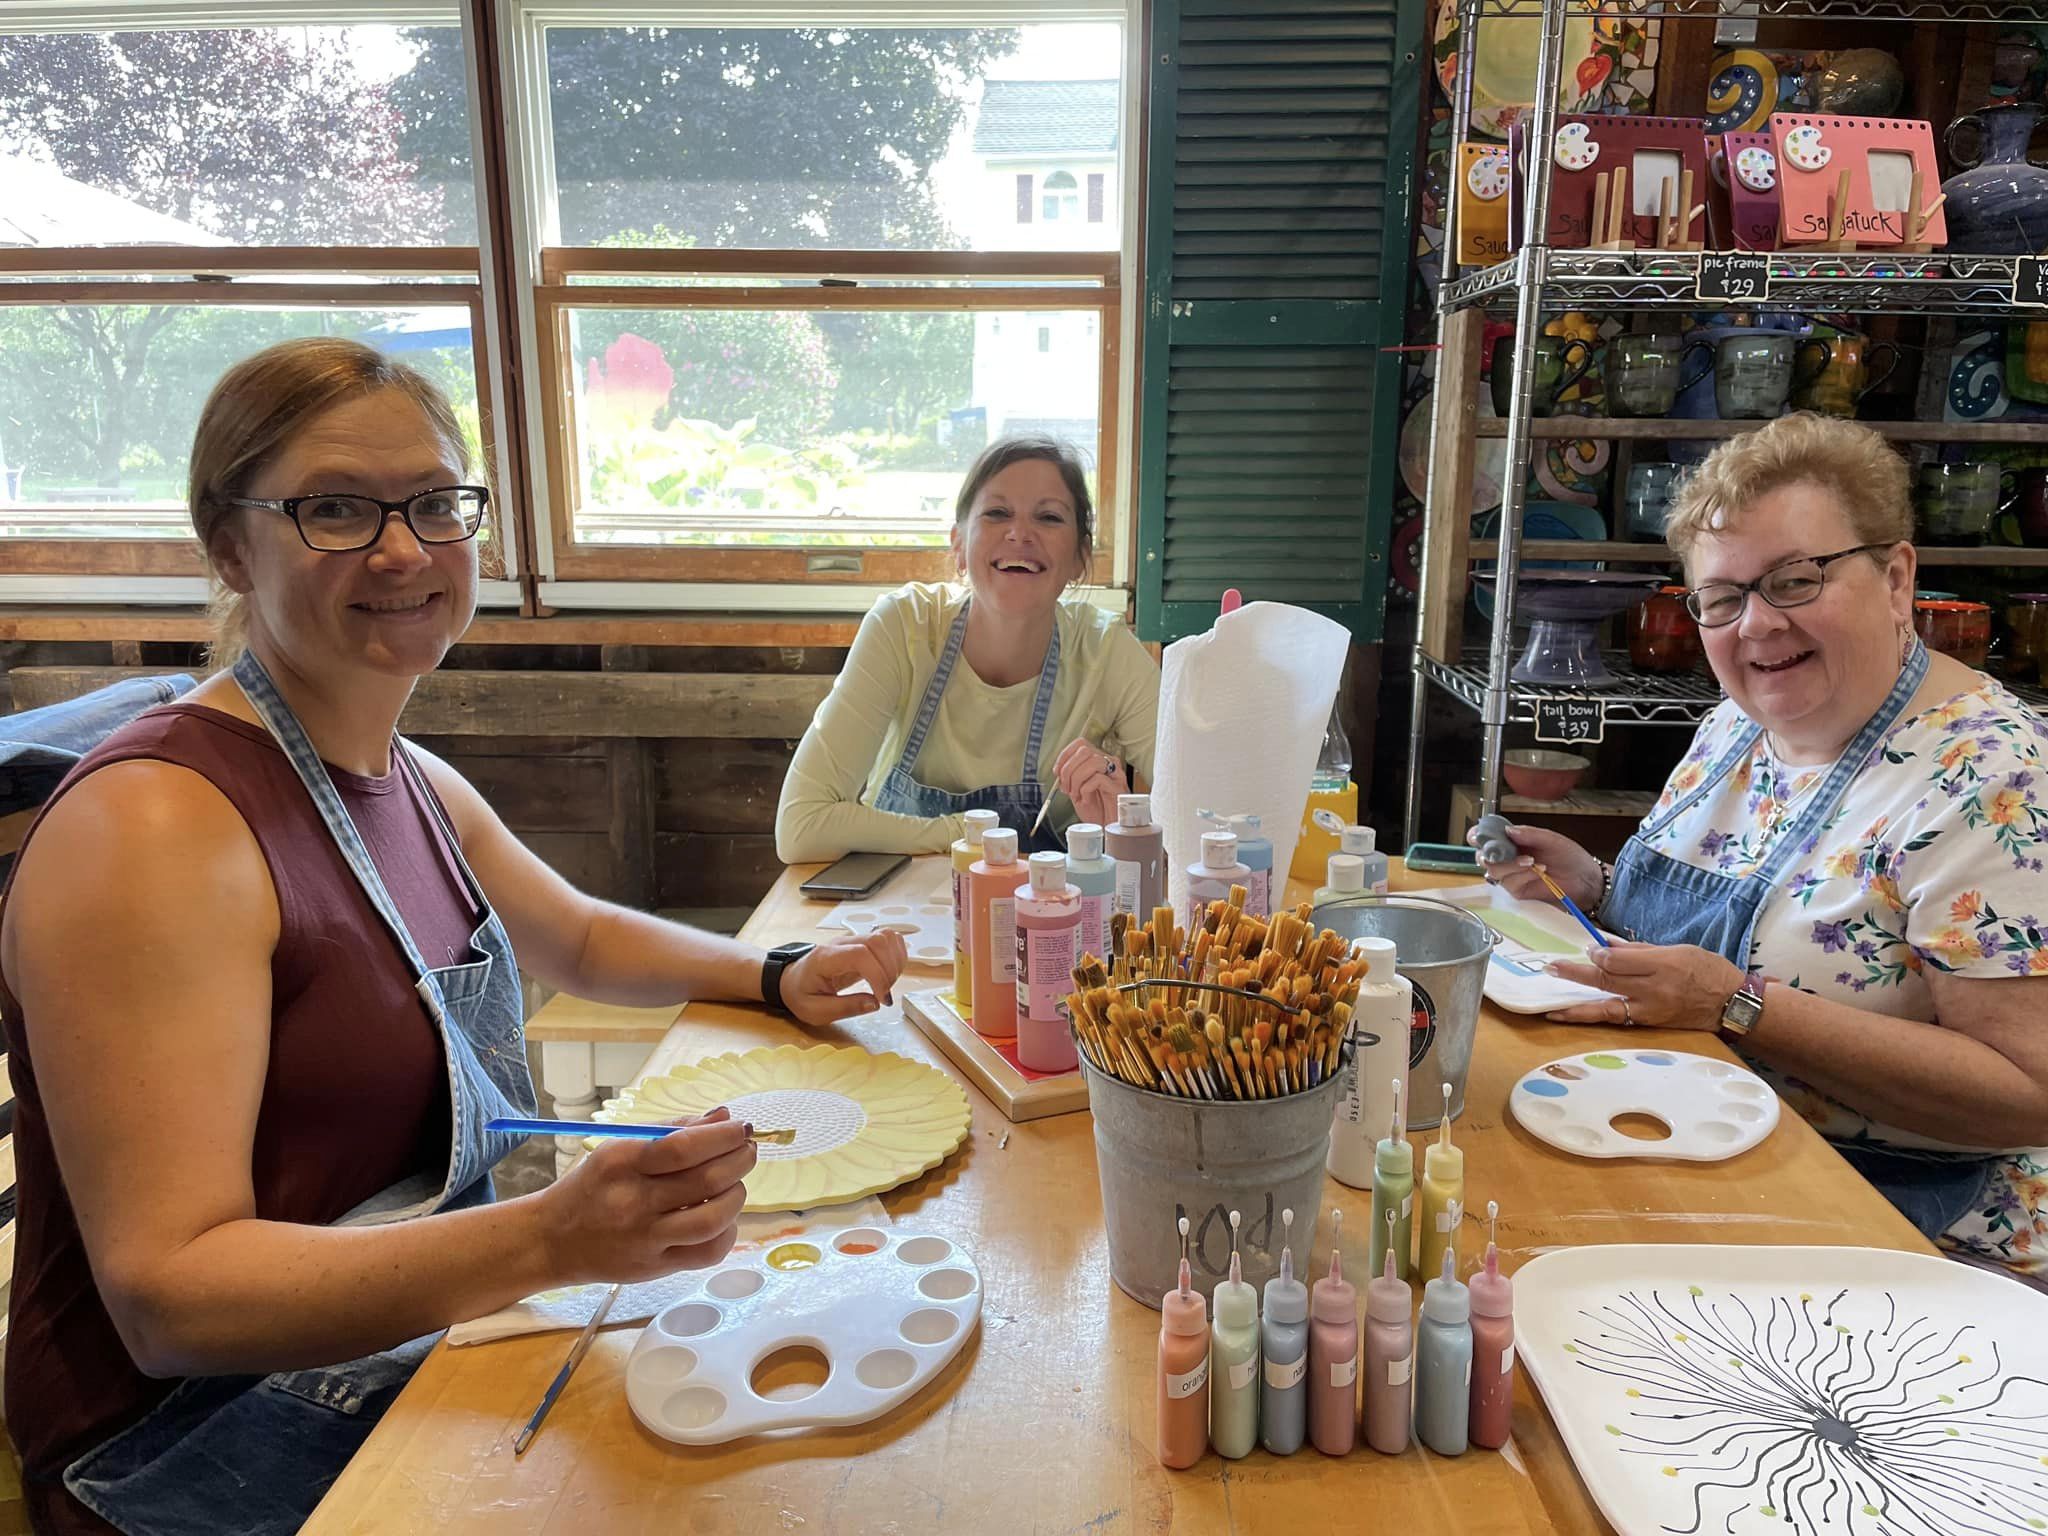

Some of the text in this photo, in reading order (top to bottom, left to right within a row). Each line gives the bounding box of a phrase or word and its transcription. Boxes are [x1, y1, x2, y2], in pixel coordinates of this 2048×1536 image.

[1704, 256, 1768, 274] pic frame
[1720, 271, 1754, 297] $29
[1542, 703, 1600, 717] tall bowl
[1557, 716, 1590, 738] $39
